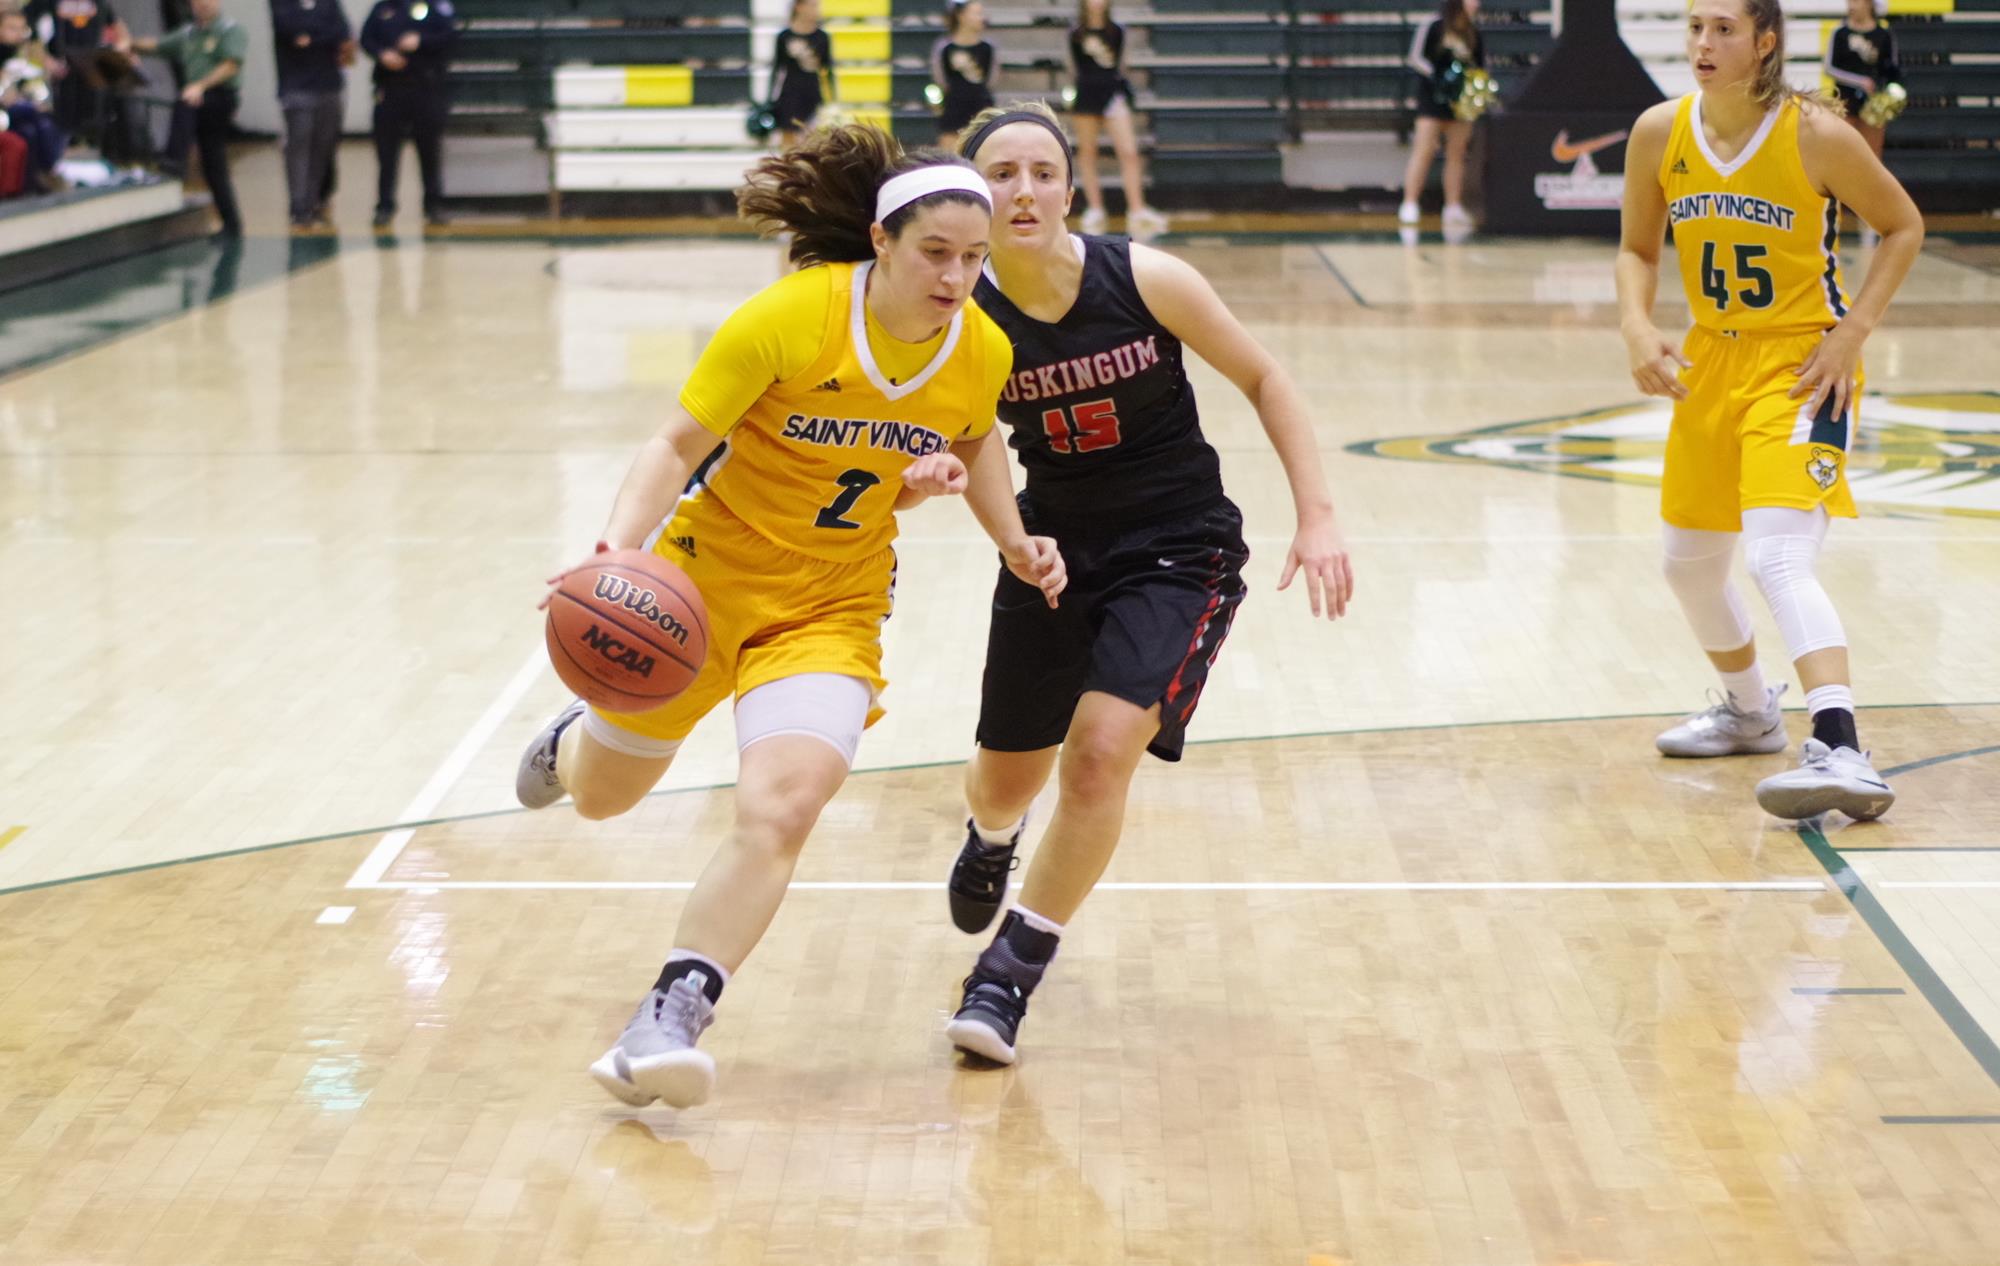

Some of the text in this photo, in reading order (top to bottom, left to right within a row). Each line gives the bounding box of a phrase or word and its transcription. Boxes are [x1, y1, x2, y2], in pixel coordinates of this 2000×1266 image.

[1669, 192, 1796, 232] SAINT VINCENT
[1700, 240, 1775, 311] 45
[999, 335, 1160, 403] USKINGUM
[780, 412, 951, 460] SAINT VINCEN
[1042, 398, 1121, 454] 15
[813, 467, 881, 530] 2
[593, 573, 690, 647] Wilson
[579, 623, 656, 679] NCAA
